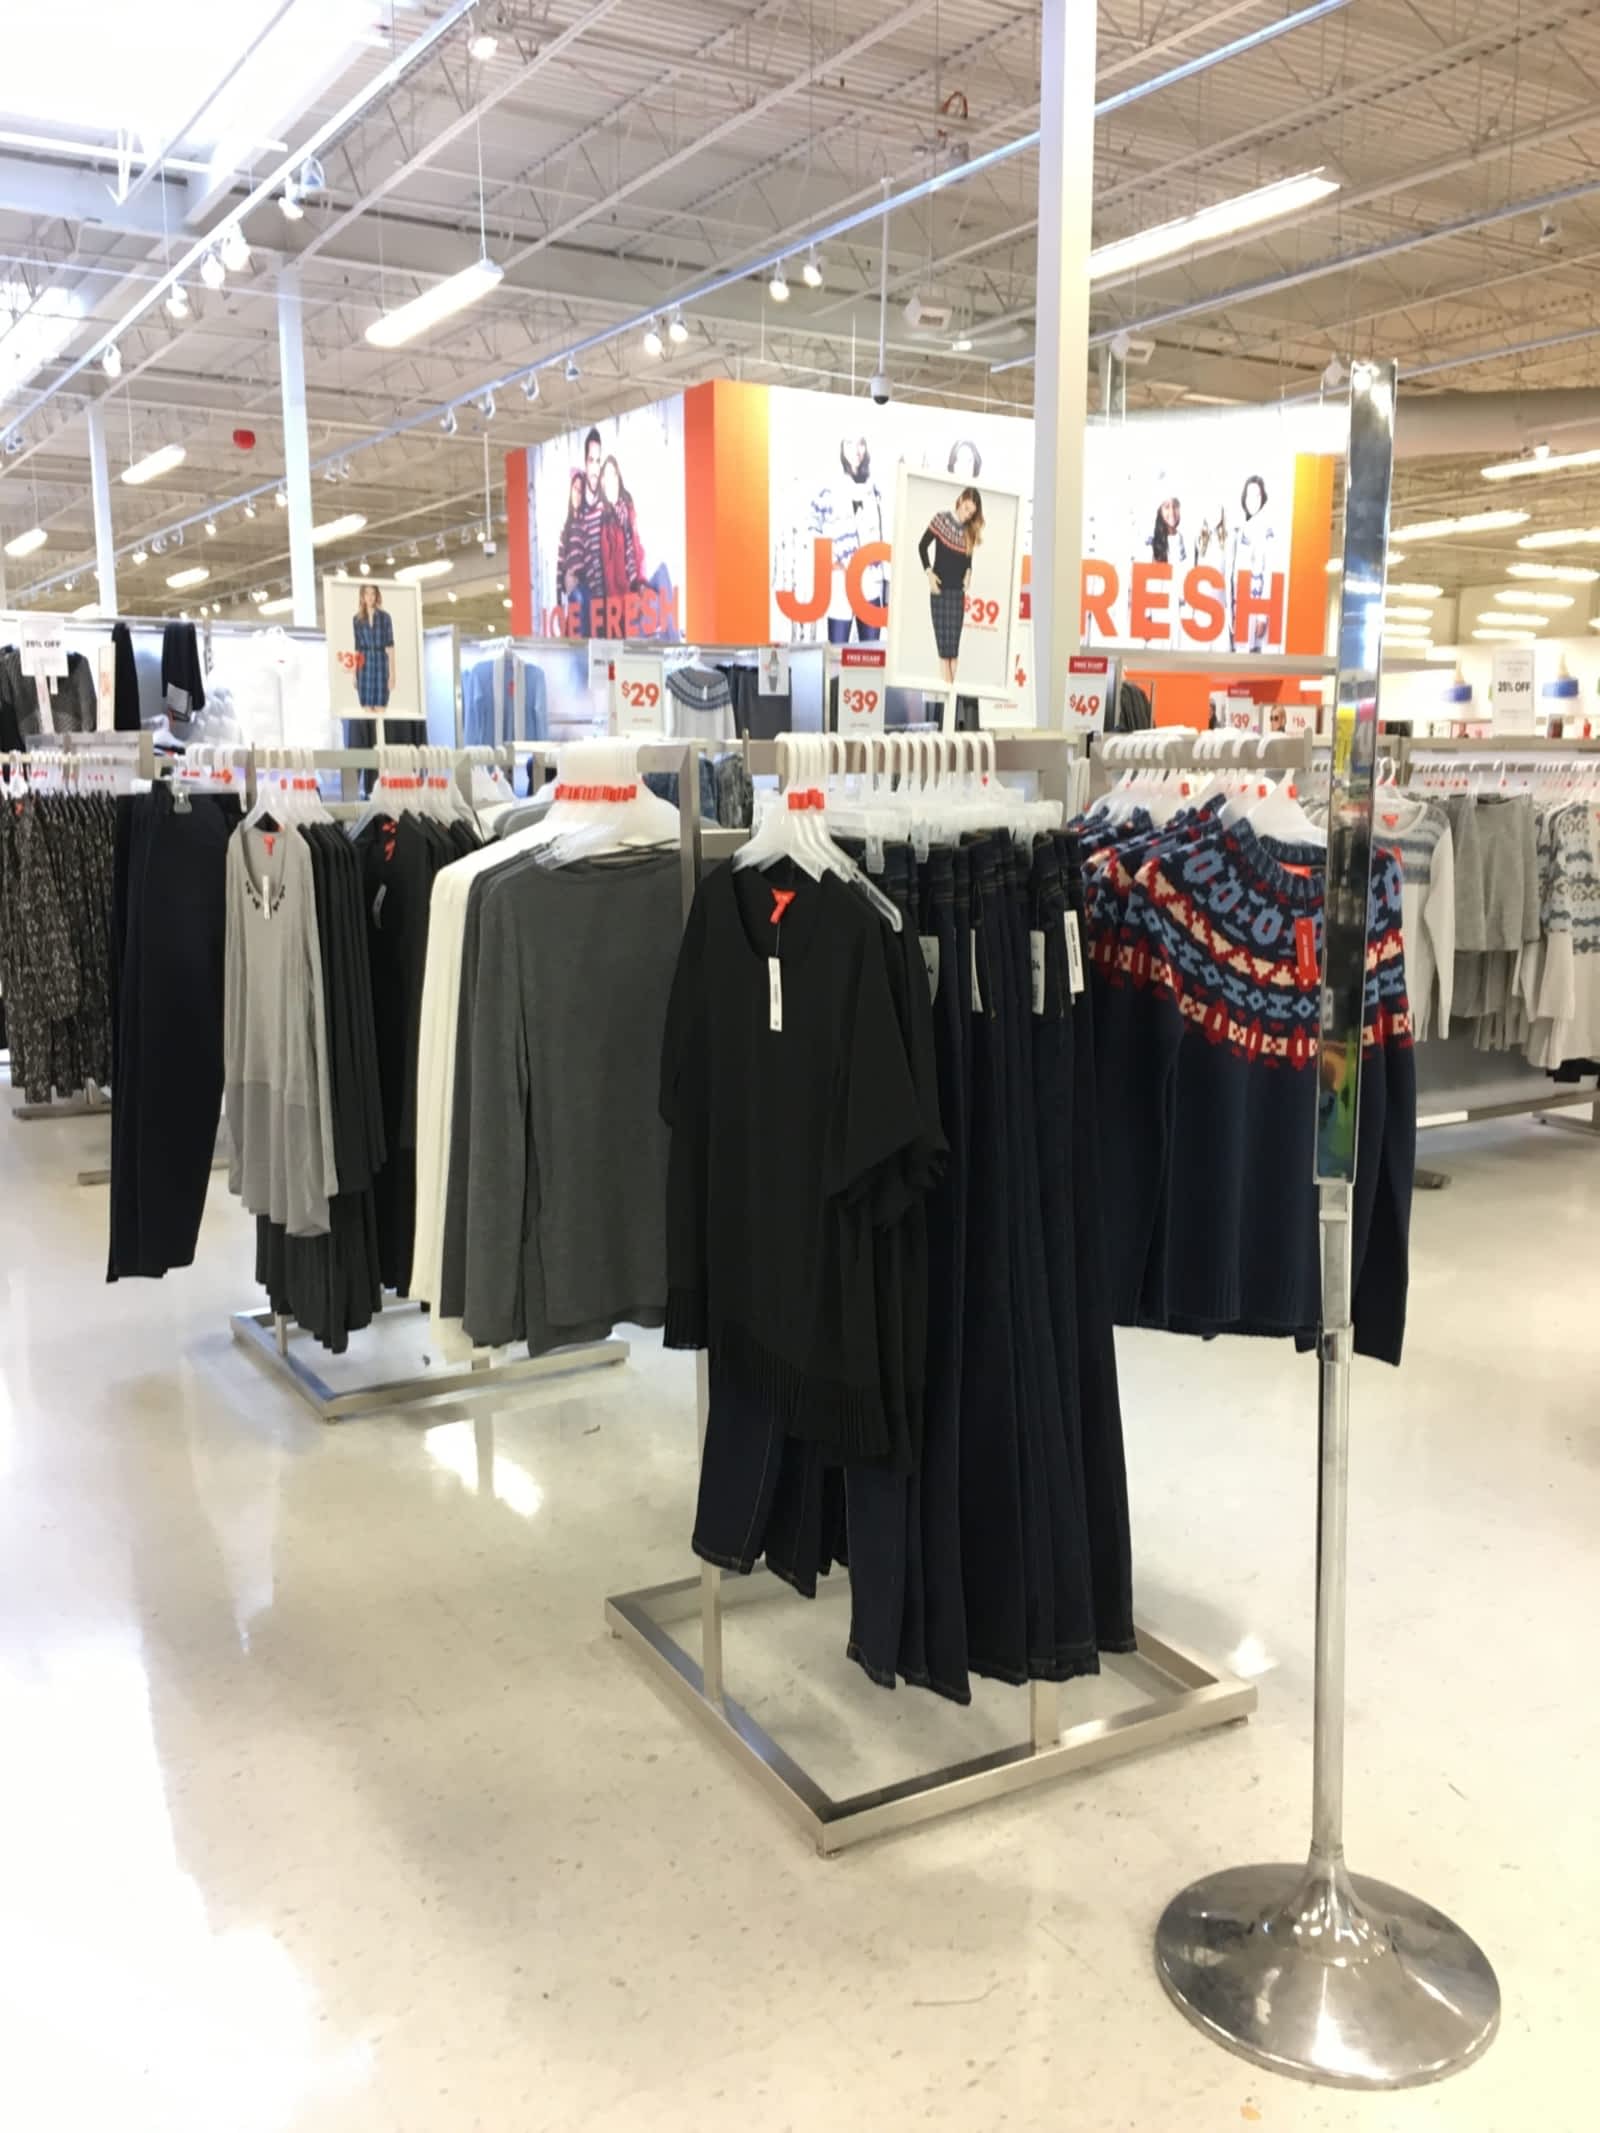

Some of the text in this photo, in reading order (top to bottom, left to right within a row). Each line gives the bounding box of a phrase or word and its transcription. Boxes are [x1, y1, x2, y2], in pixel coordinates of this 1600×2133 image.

[540, 584, 680, 639] JOE FRESH
[964, 594, 1000, 625] $39
[1022, 555, 1284, 645] RESH
[622, 680, 660, 708] $29
[1515, 681, 1531, 692] OFF
[843, 688, 879, 715] $39
[1069, 694, 1101, 717] $49
